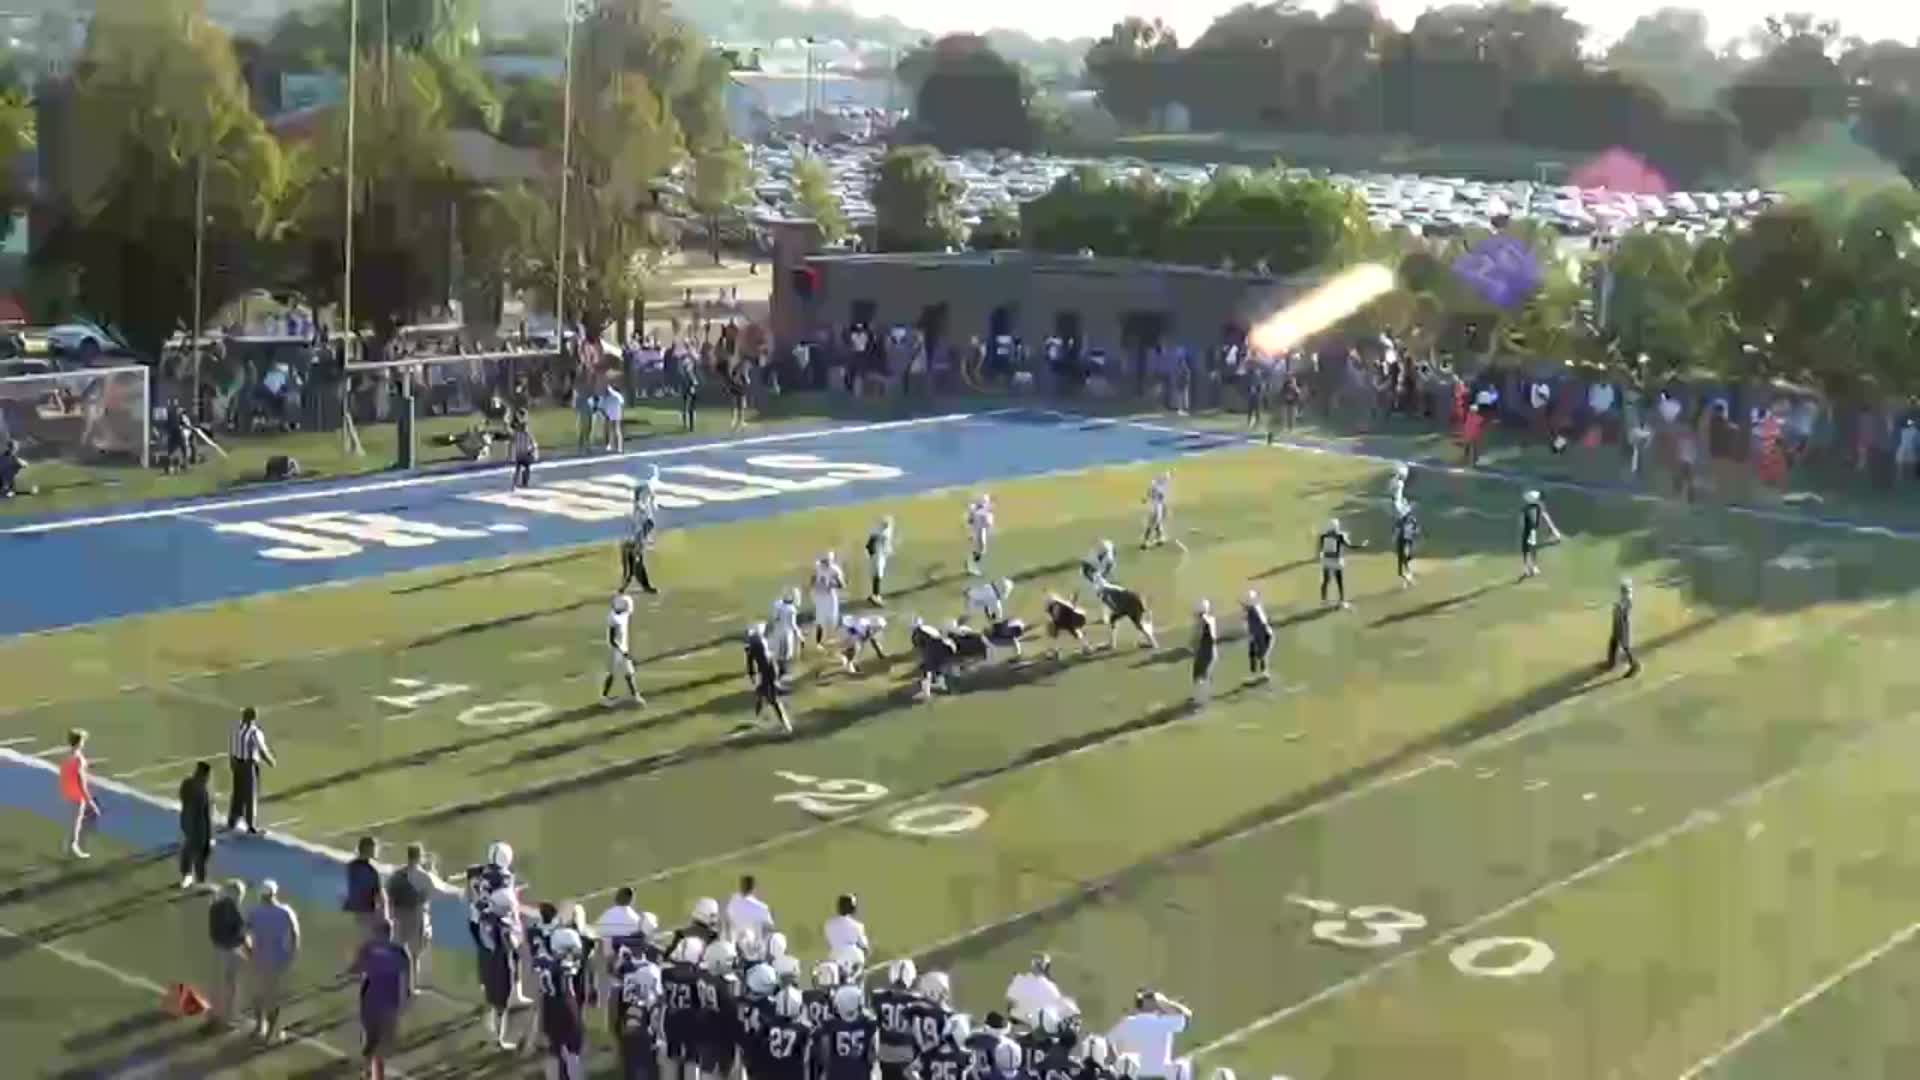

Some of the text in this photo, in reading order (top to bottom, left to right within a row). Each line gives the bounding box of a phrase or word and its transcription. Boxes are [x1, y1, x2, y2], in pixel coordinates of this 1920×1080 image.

[212, 510, 528, 559] JR.
[773, 779, 989, 836] 20
[1312, 905, 1554, 976] 30
[770, 1027, 797, 1058] 27
